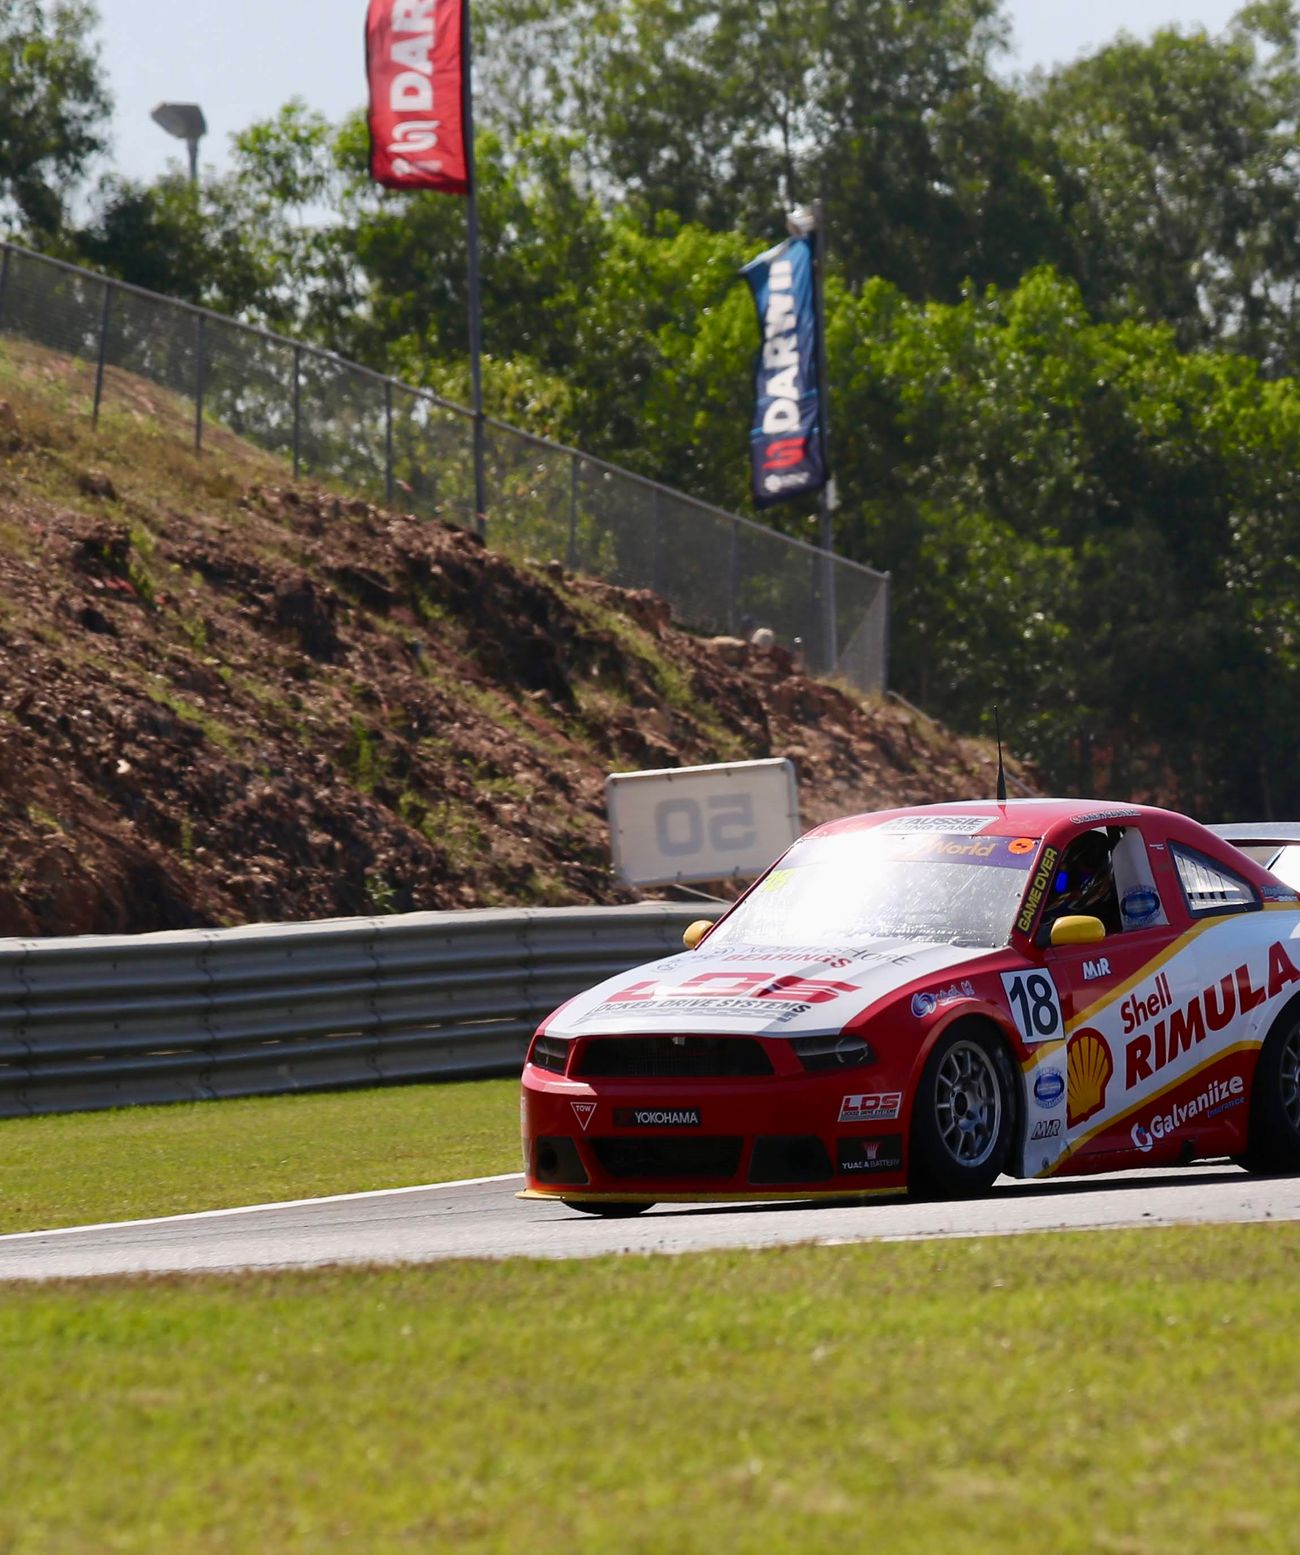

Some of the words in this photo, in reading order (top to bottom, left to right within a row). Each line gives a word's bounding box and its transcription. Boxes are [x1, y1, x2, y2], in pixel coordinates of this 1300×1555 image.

[905, 817, 988, 826] AUSSIE
[934, 824, 976, 832] CARS
[663, 1000, 714, 1009] DRIVE
[1008, 974, 1059, 1037] 18
[1121, 972, 1172, 1035] Shell
[842, 1093, 900, 1112] LDS
[635, 1111, 699, 1124] YOKOHAMA
